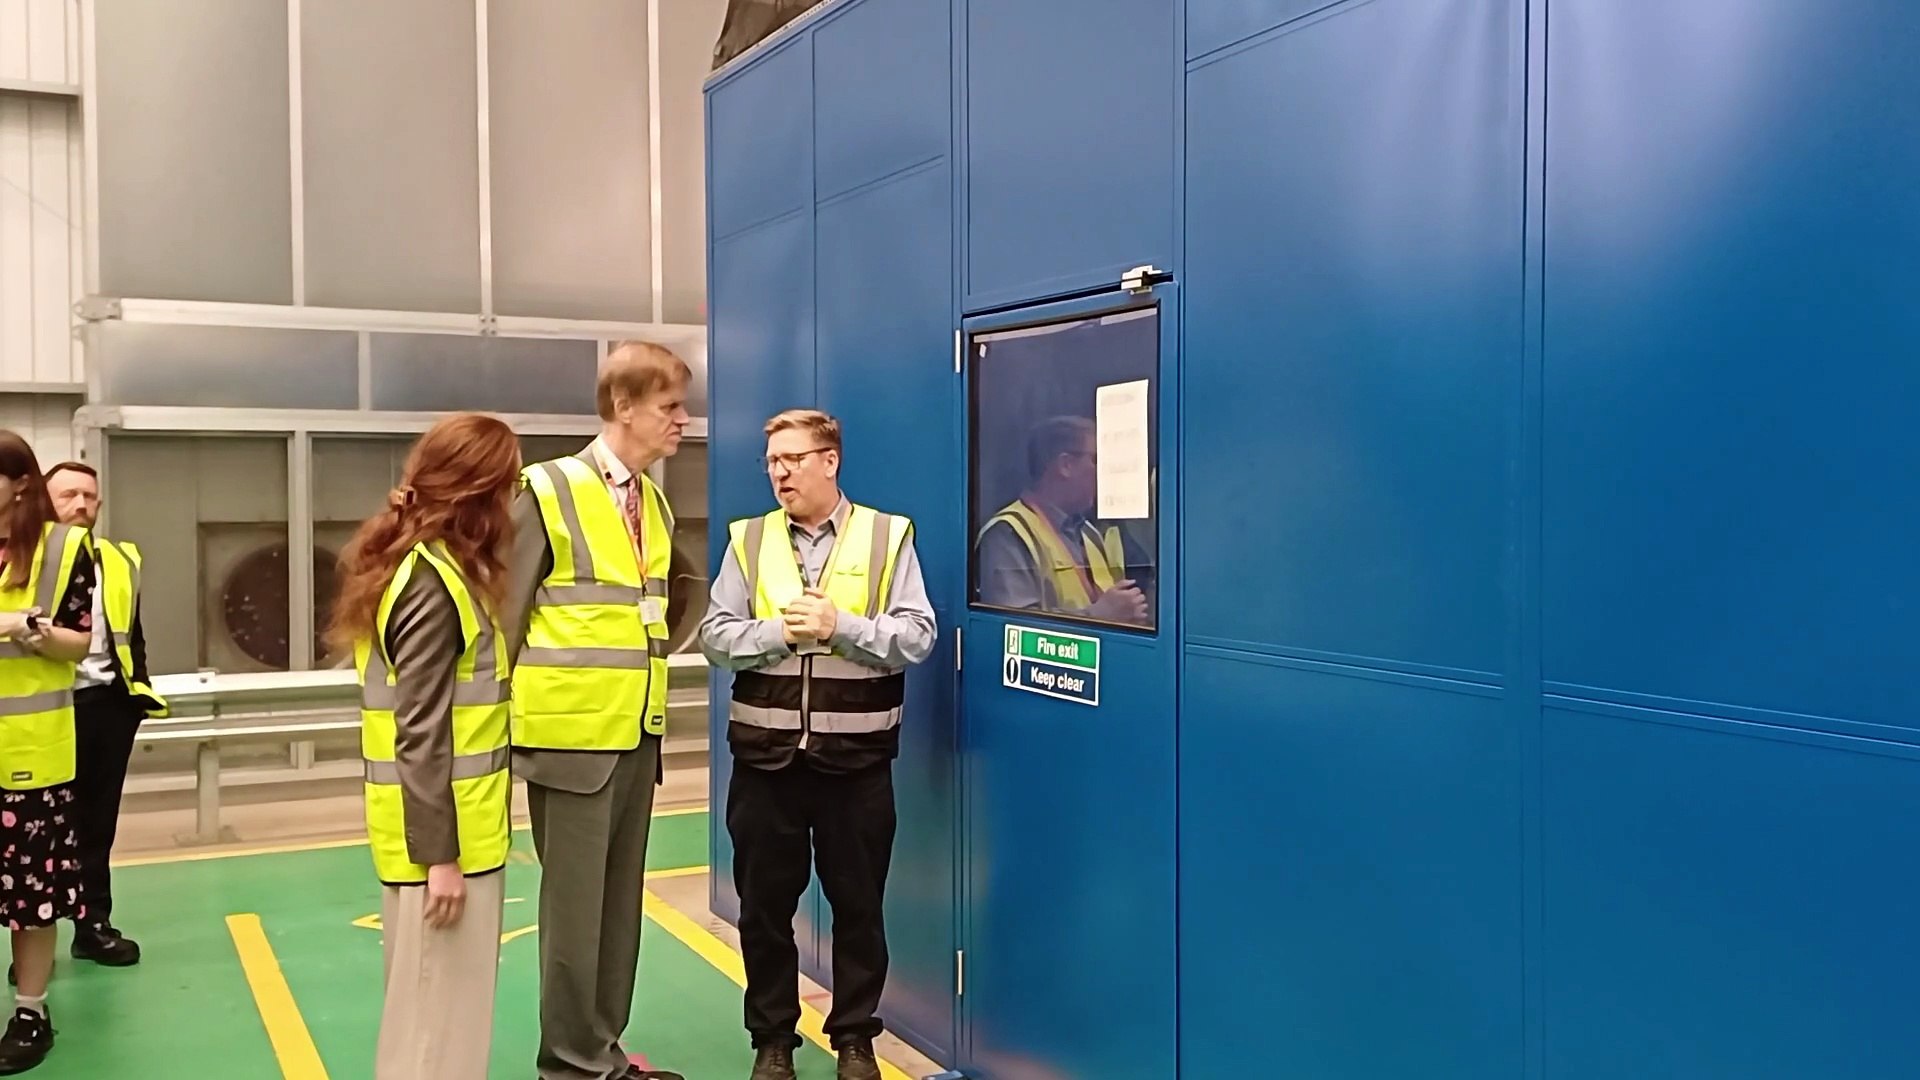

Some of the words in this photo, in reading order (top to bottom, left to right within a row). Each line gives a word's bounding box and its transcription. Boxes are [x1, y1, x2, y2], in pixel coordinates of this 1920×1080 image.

[1037, 636, 1056, 656] Fire
[1058, 642, 1079, 660] exit
[1031, 666, 1055, 690] Keep
[1057, 672, 1085, 692] clear
